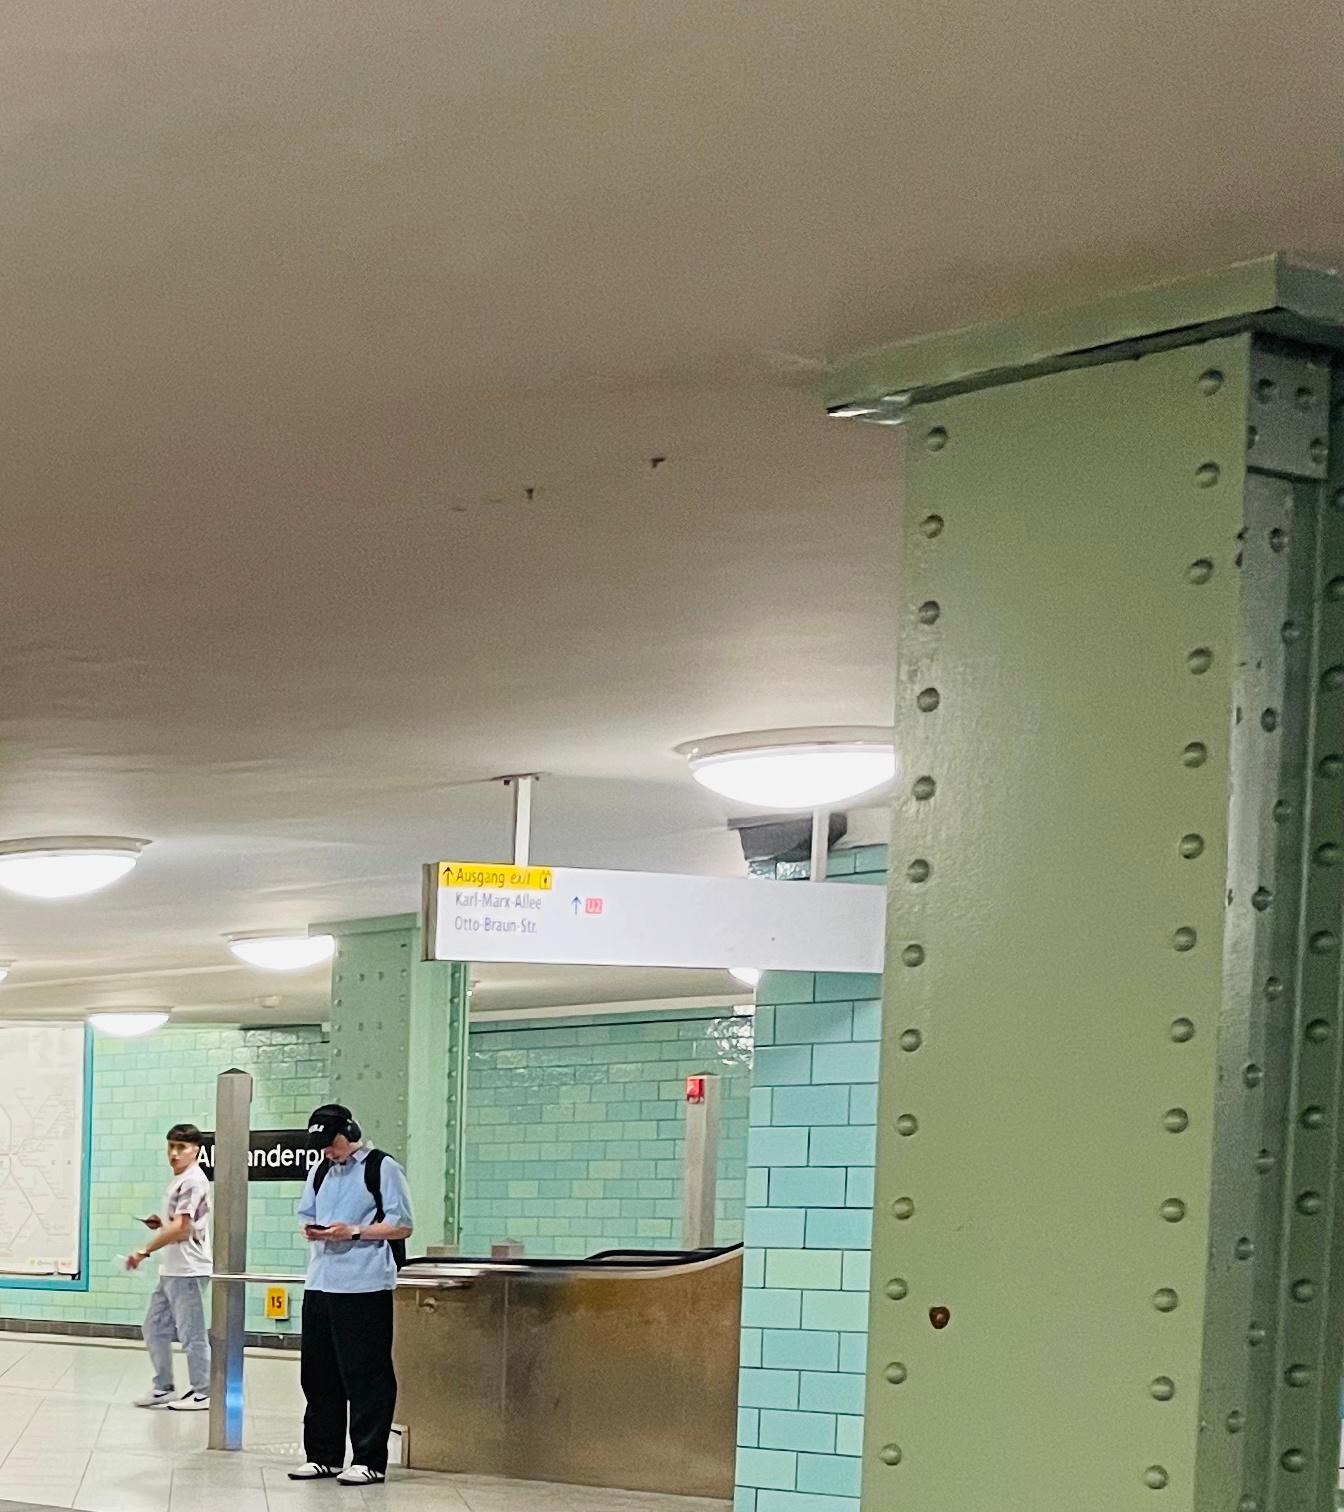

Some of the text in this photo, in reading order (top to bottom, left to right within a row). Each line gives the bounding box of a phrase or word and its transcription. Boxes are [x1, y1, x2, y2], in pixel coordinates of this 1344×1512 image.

[455, 868, 531, 888] Ausgang exit
[455, 892, 542, 910] Karl-Marx-Allee
[587, 900, 603, 913] U2
[270, 1295, 283, 1309] 15
